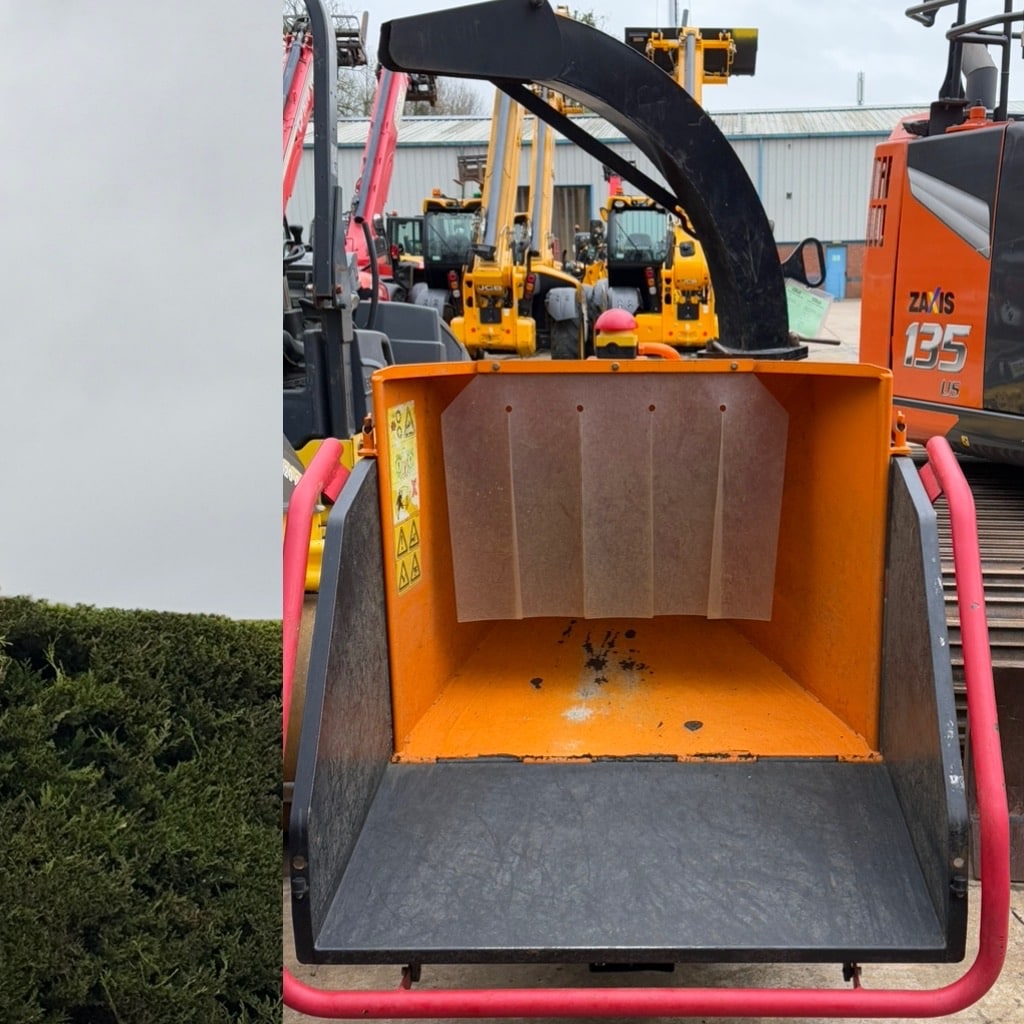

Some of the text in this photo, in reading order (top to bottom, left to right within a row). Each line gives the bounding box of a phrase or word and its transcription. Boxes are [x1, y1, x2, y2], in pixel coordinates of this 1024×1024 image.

[908, 287, 955, 315] ZAXIS
[904, 322, 971, 373] 135
[940, 380, 960, 397] US
